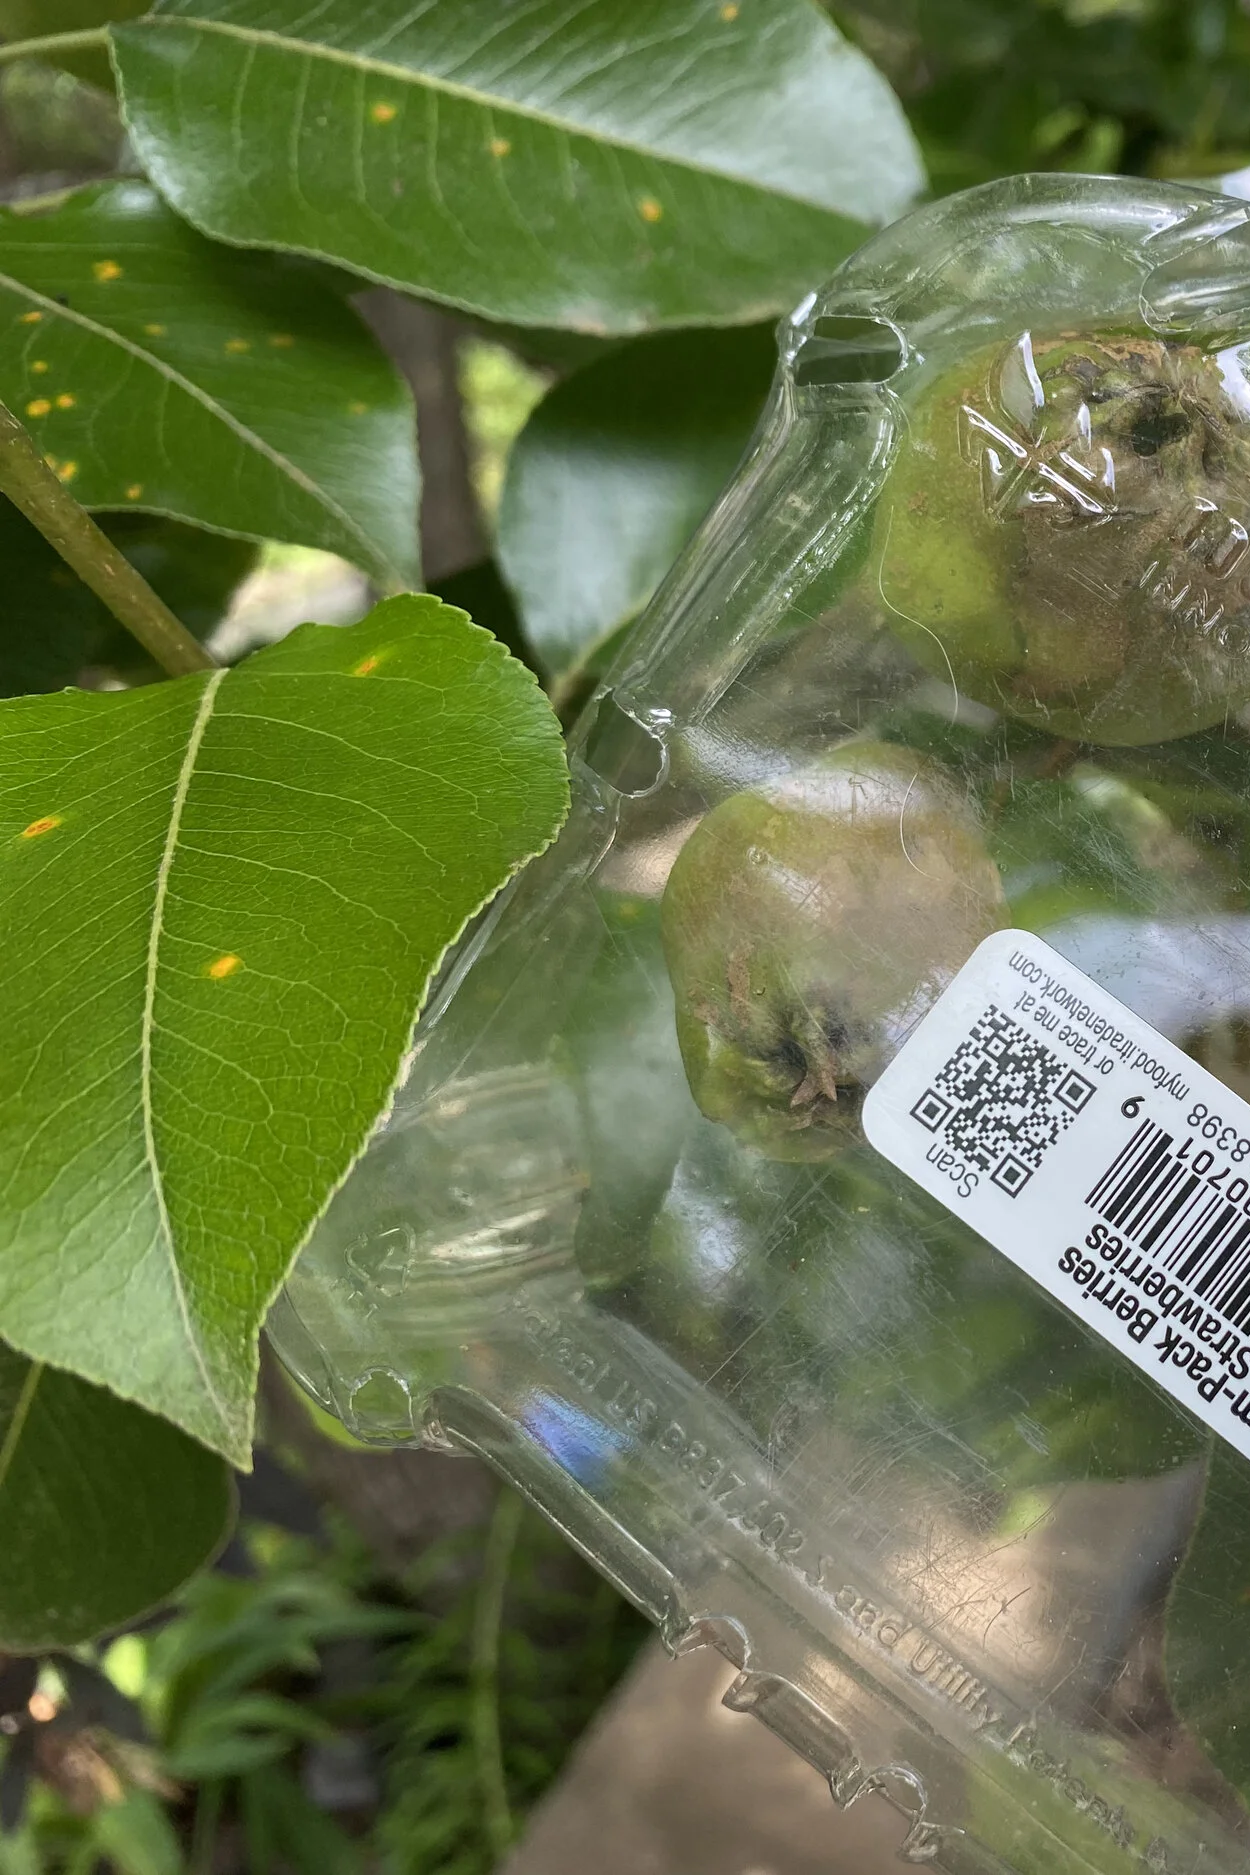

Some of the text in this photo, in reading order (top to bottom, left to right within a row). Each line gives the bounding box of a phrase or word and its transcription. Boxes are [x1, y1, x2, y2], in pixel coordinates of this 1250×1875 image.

[1009, 951, 1190, 1101] myfood.itradenetwork.com
[1013, 991, 1114, 1075] or trace me at
[1120, 1095, 1146, 1119] 9
[925, 1143, 979, 1198] Scan
[1057, 1246, 1160, 1345] Berries
[829, 1572, 914, 1652] and
[897, 1636, 1011, 1743] Utility
